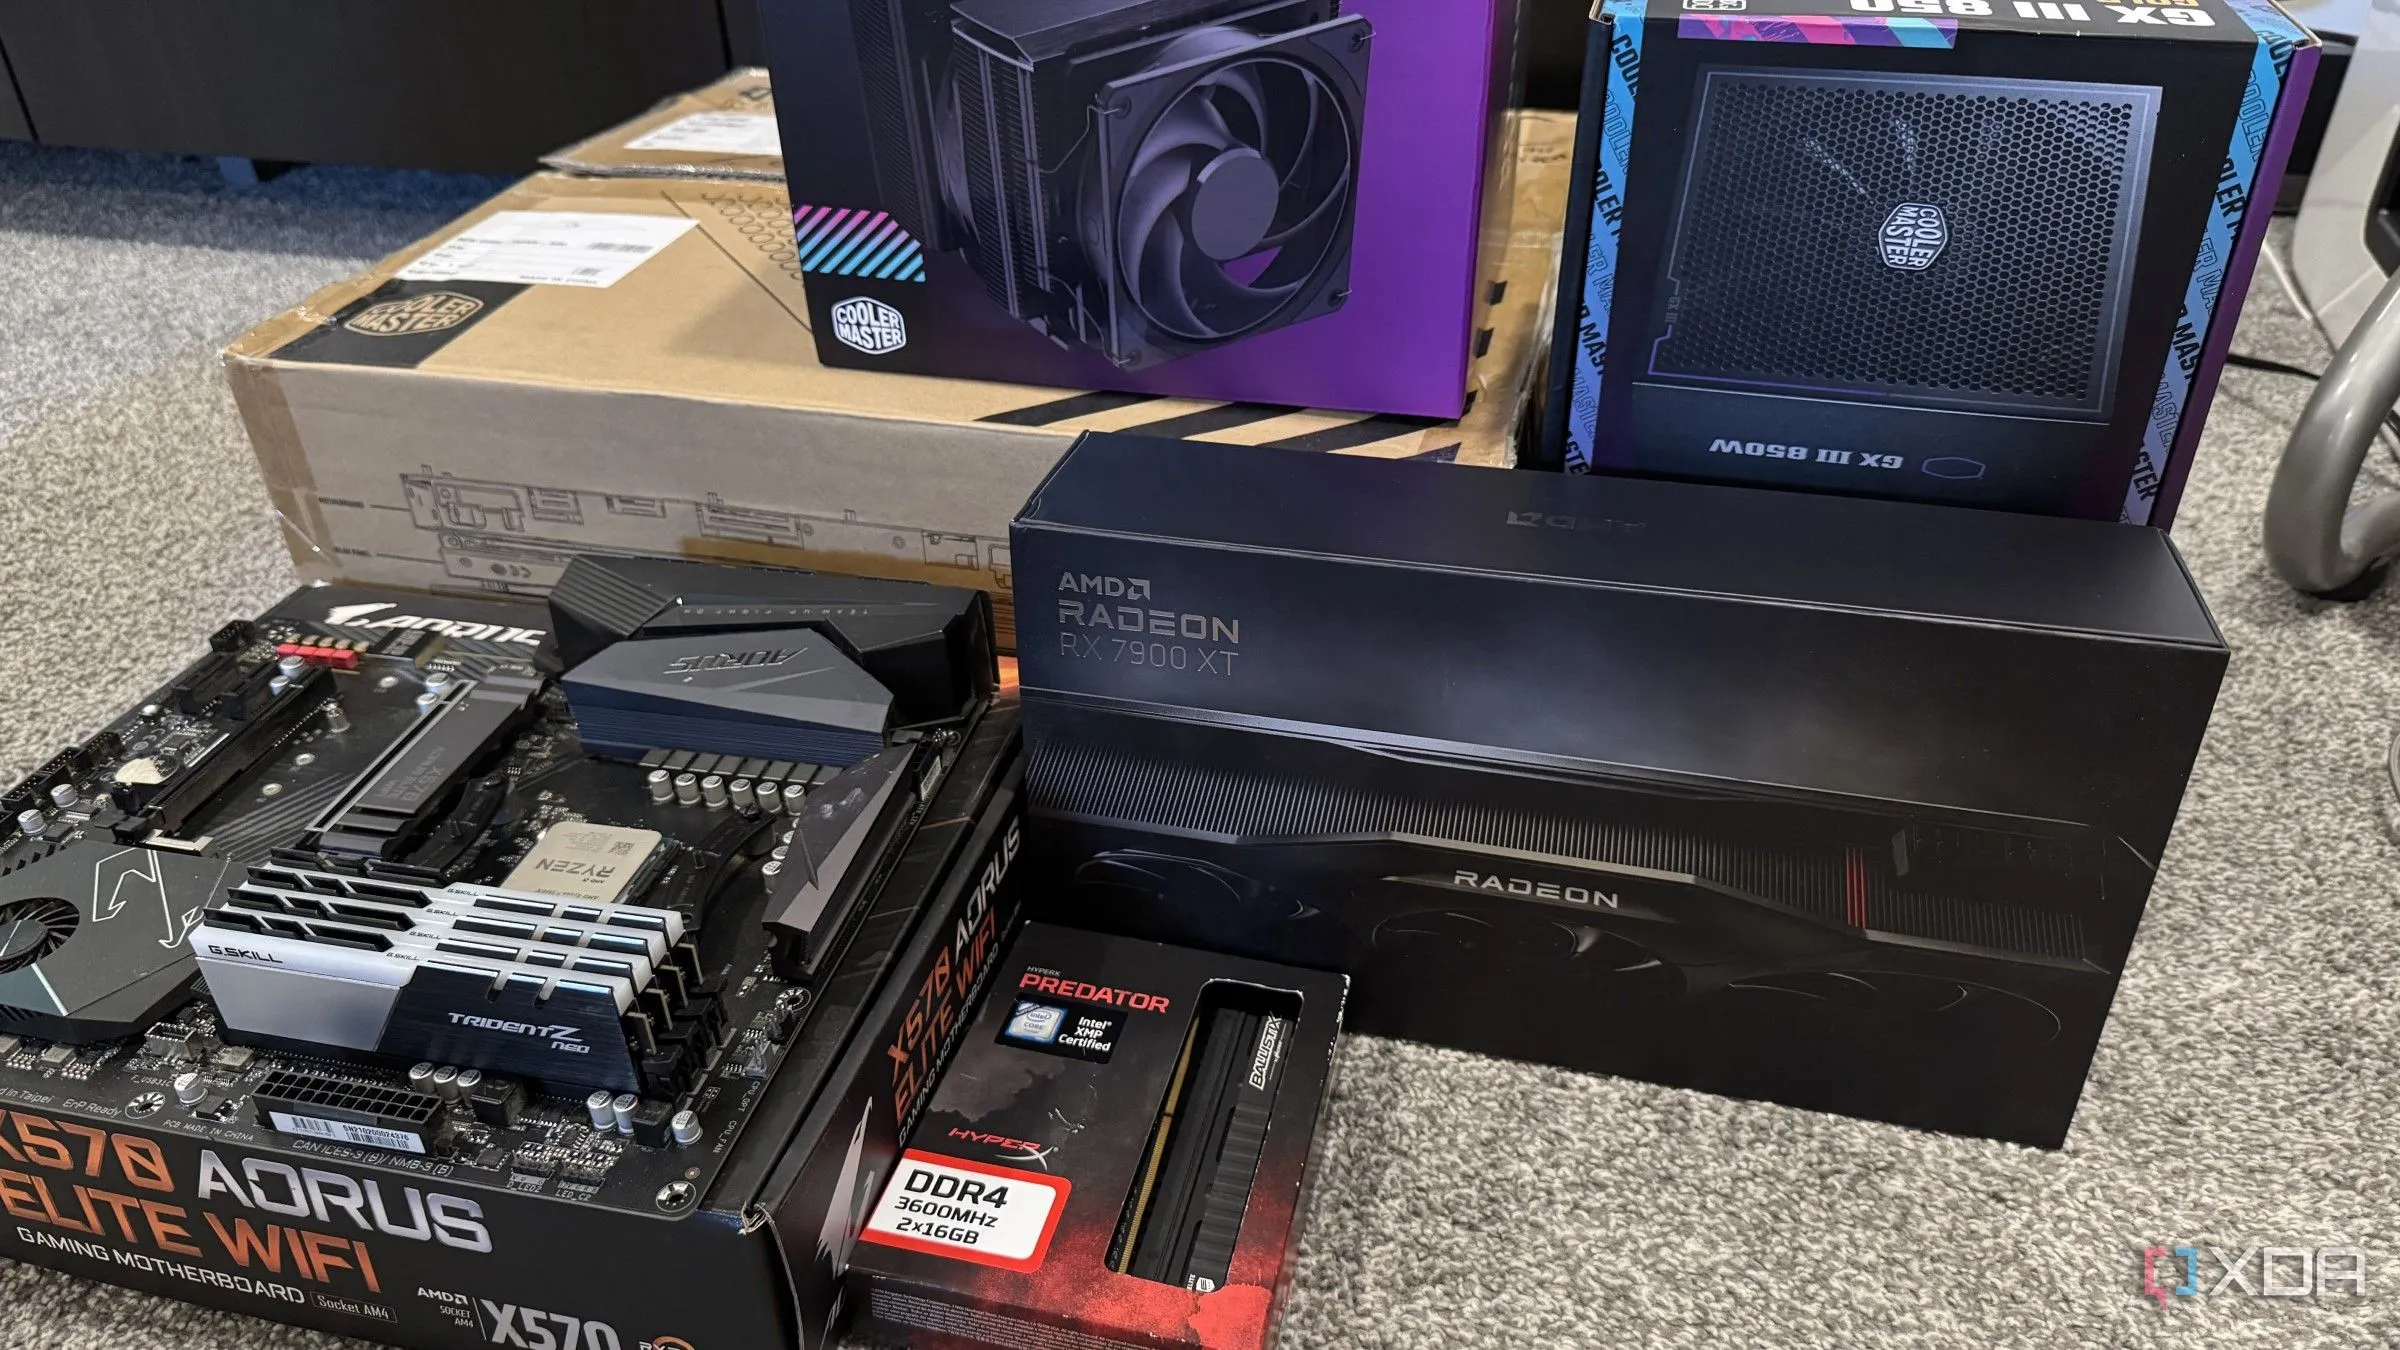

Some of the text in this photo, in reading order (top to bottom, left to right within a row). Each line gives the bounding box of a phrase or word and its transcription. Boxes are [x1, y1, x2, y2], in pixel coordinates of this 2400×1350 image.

[2009, 0, 2092, 21] III
[2104, 5, 2216, 27] GX
[1884, 206, 1919, 265] MASTER
[1907, 207, 1943, 267] COOLER
[370, 293, 474, 319] COOLER
[837, 301, 900, 328] COOLER
[351, 311, 461, 335] MASTER
[838, 323, 902, 349] MASTER
[1708, 438, 1904, 470] GX III 850W
[1057, 571, 1126, 597] AMD
[1057, 598, 1240, 645] RADEON
[663, 646, 808, 675] AORUS
[1059, 631, 1240, 676] RX 7900 XT
[534, 857, 616, 878] RYZEN
[1453, 868, 1619, 910] RADEON
[207, 944, 284, 964] G.SKILL
[887, 814, 1021, 1085] X570 AORUS
[1026, 966, 1062, 977] HYPERX
[1018, 973, 1170, 1013] PREDATOR
[894, 904, 996, 1127] ELITE WIFI
[1058, 1033, 1112, 1052] Certified
[1074, 1027, 1103, 1039] XMP
[1249, 1010, 1282, 1090] BALLISTIX
[21, 1089, 53, 1105] Taipei
[62, 1097, 87, 1112] ErP
[87, 1103, 122, 1119] Ready
[163, 1119, 254, 1142] PCB MADE IN CHINA
[292, 1139, 318, 1152] CAN
[320, 1144, 362, 1160] ICES-3
[390, 1156, 431, 1172] NMB-3
[432, 1163, 454, 1177] (B)
[198, 1148, 494, 1254] AORUS
[904, 1168, 1009, 1209] DDR4
[894, 1195, 999, 1229] 3600MHz
[0, 1166, 382, 1294] ELITE WIFI
[896, 1217, 980, 1245] 2x16GB
[15, 1225, 390, 1321] GAMING MOTHERBOARD Socket AM4
[417, 1286, 454, 1303] AMD
[439, 1305, 471, 1319] SOCKET
[454, 1317, 474, 1329] AM4
[480, 1298, 622, 1350] X570
